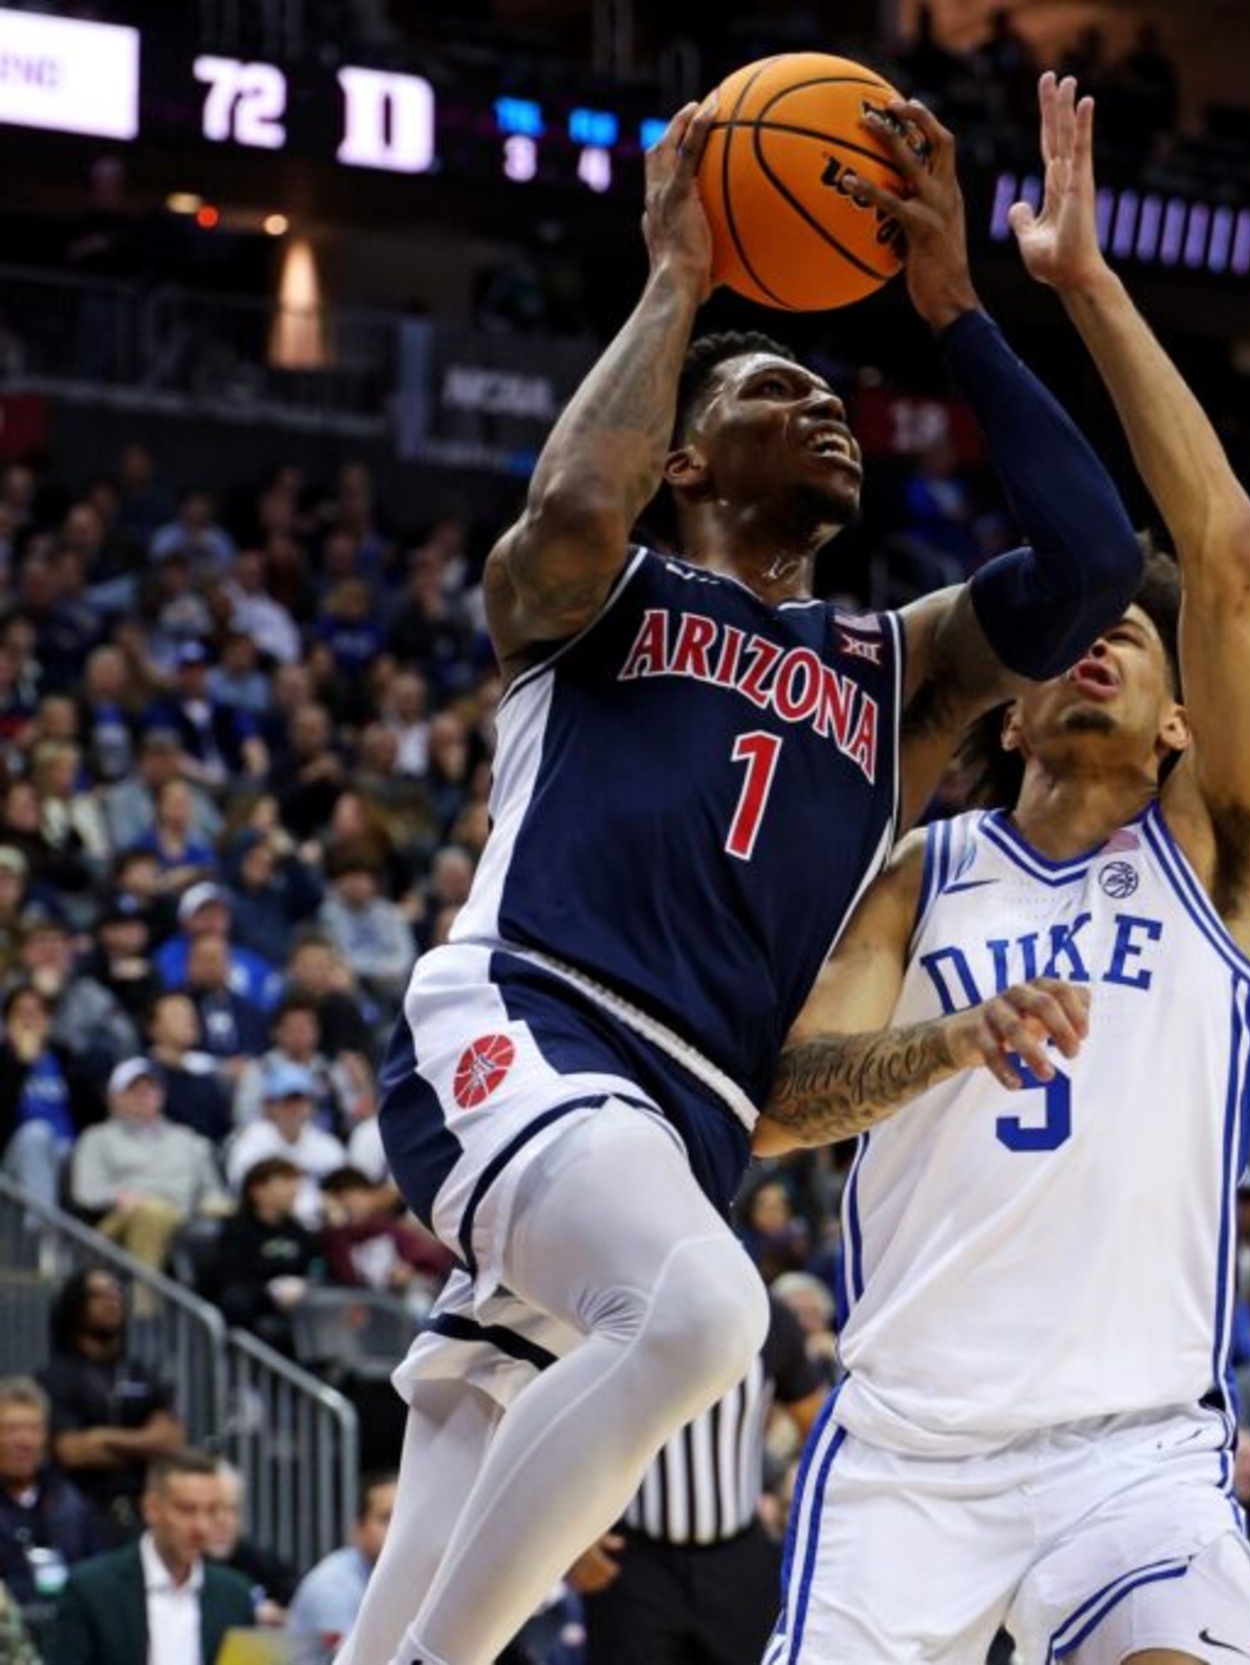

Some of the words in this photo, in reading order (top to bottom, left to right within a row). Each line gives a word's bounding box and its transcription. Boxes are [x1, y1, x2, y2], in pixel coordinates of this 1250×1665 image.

[194, 55, 287, 149] 72
[337, 66, 435, 173] D
[617, 609, 878, 786] ARIZONA
[724, 729, 783, 861] 1
[919, 911, 1163, 1017] DUKE
